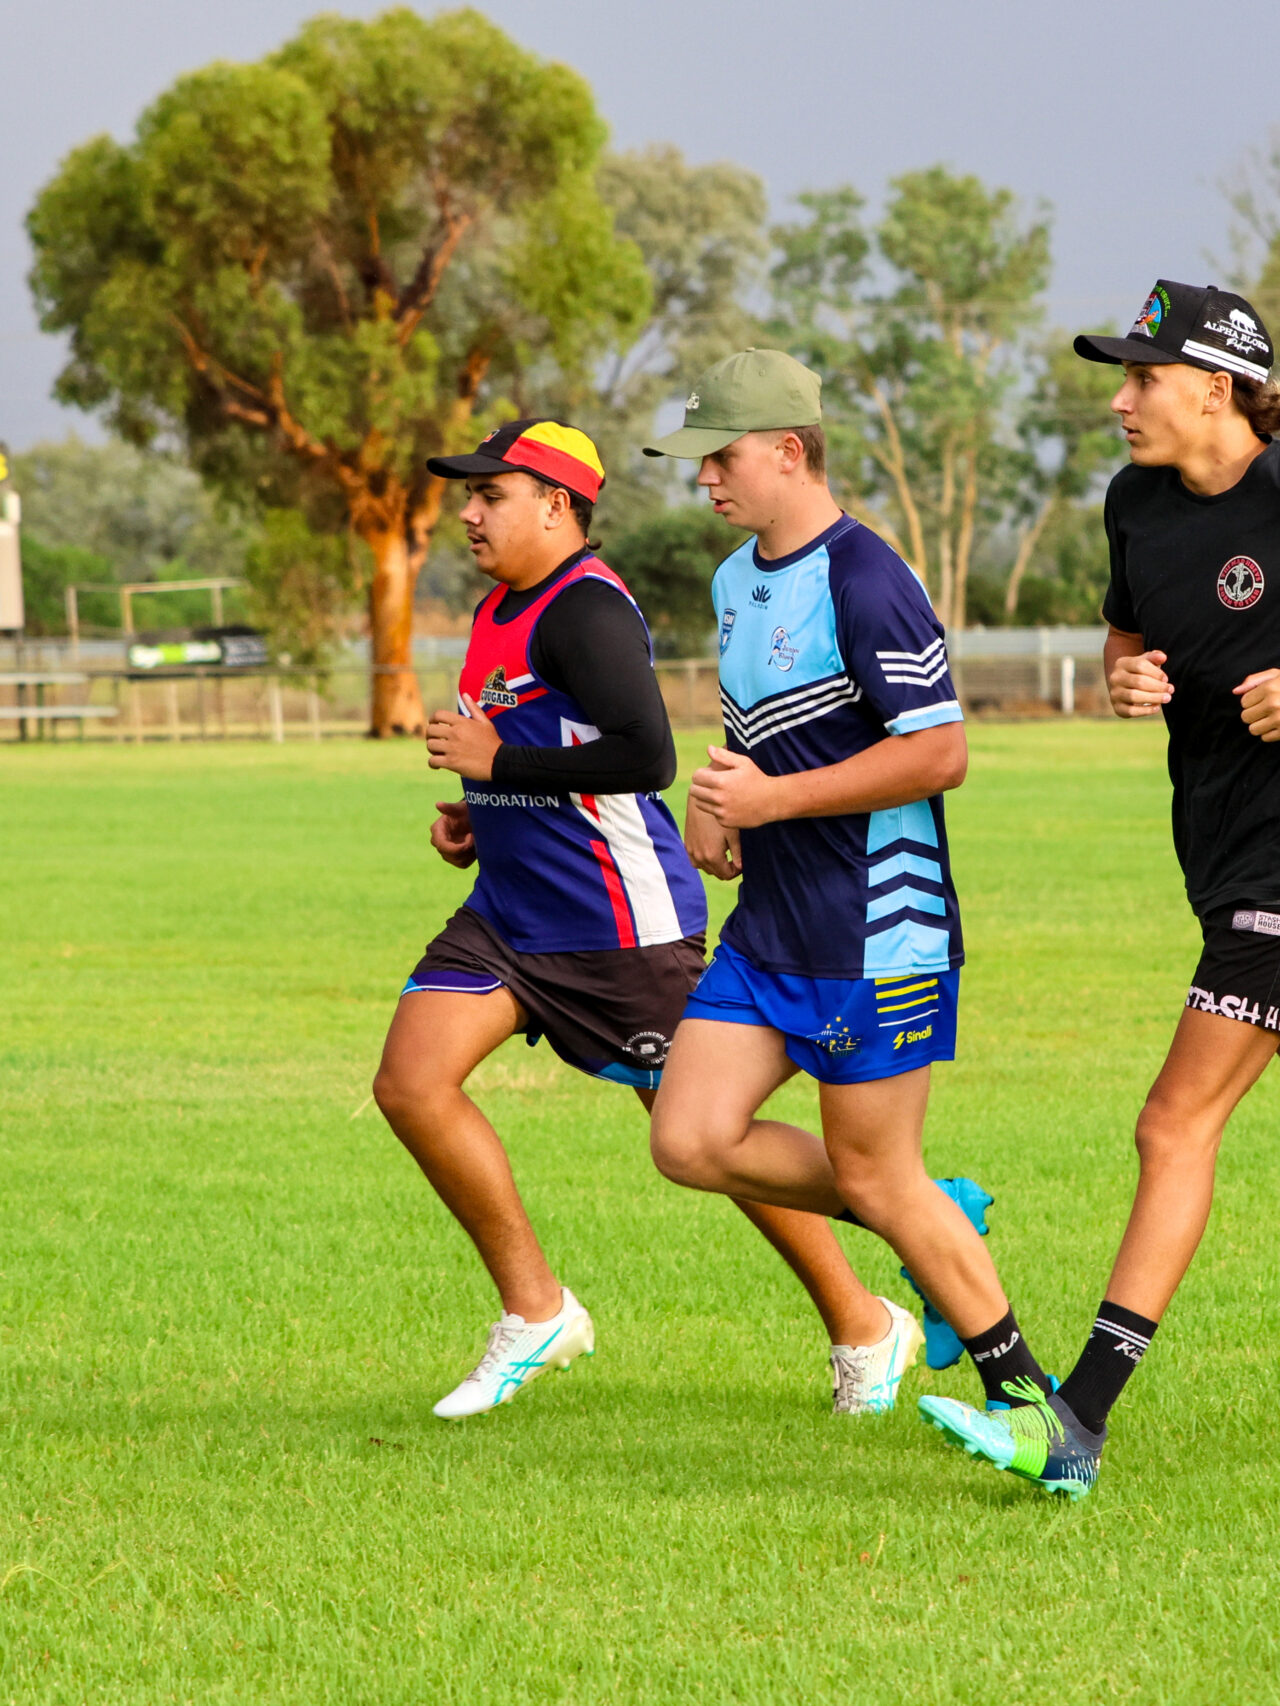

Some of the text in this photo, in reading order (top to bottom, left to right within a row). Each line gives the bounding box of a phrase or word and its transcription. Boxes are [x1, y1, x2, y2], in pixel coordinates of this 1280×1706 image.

[1204, 320, 1239, 340] ALPHA
[481, 690, 517, 706] COUGARS
[466, 791, 560, 808] CORPORATION
[1257, 921, 1280, 931] HOUSE
[974, 1331, 1020, 1363] FILA
